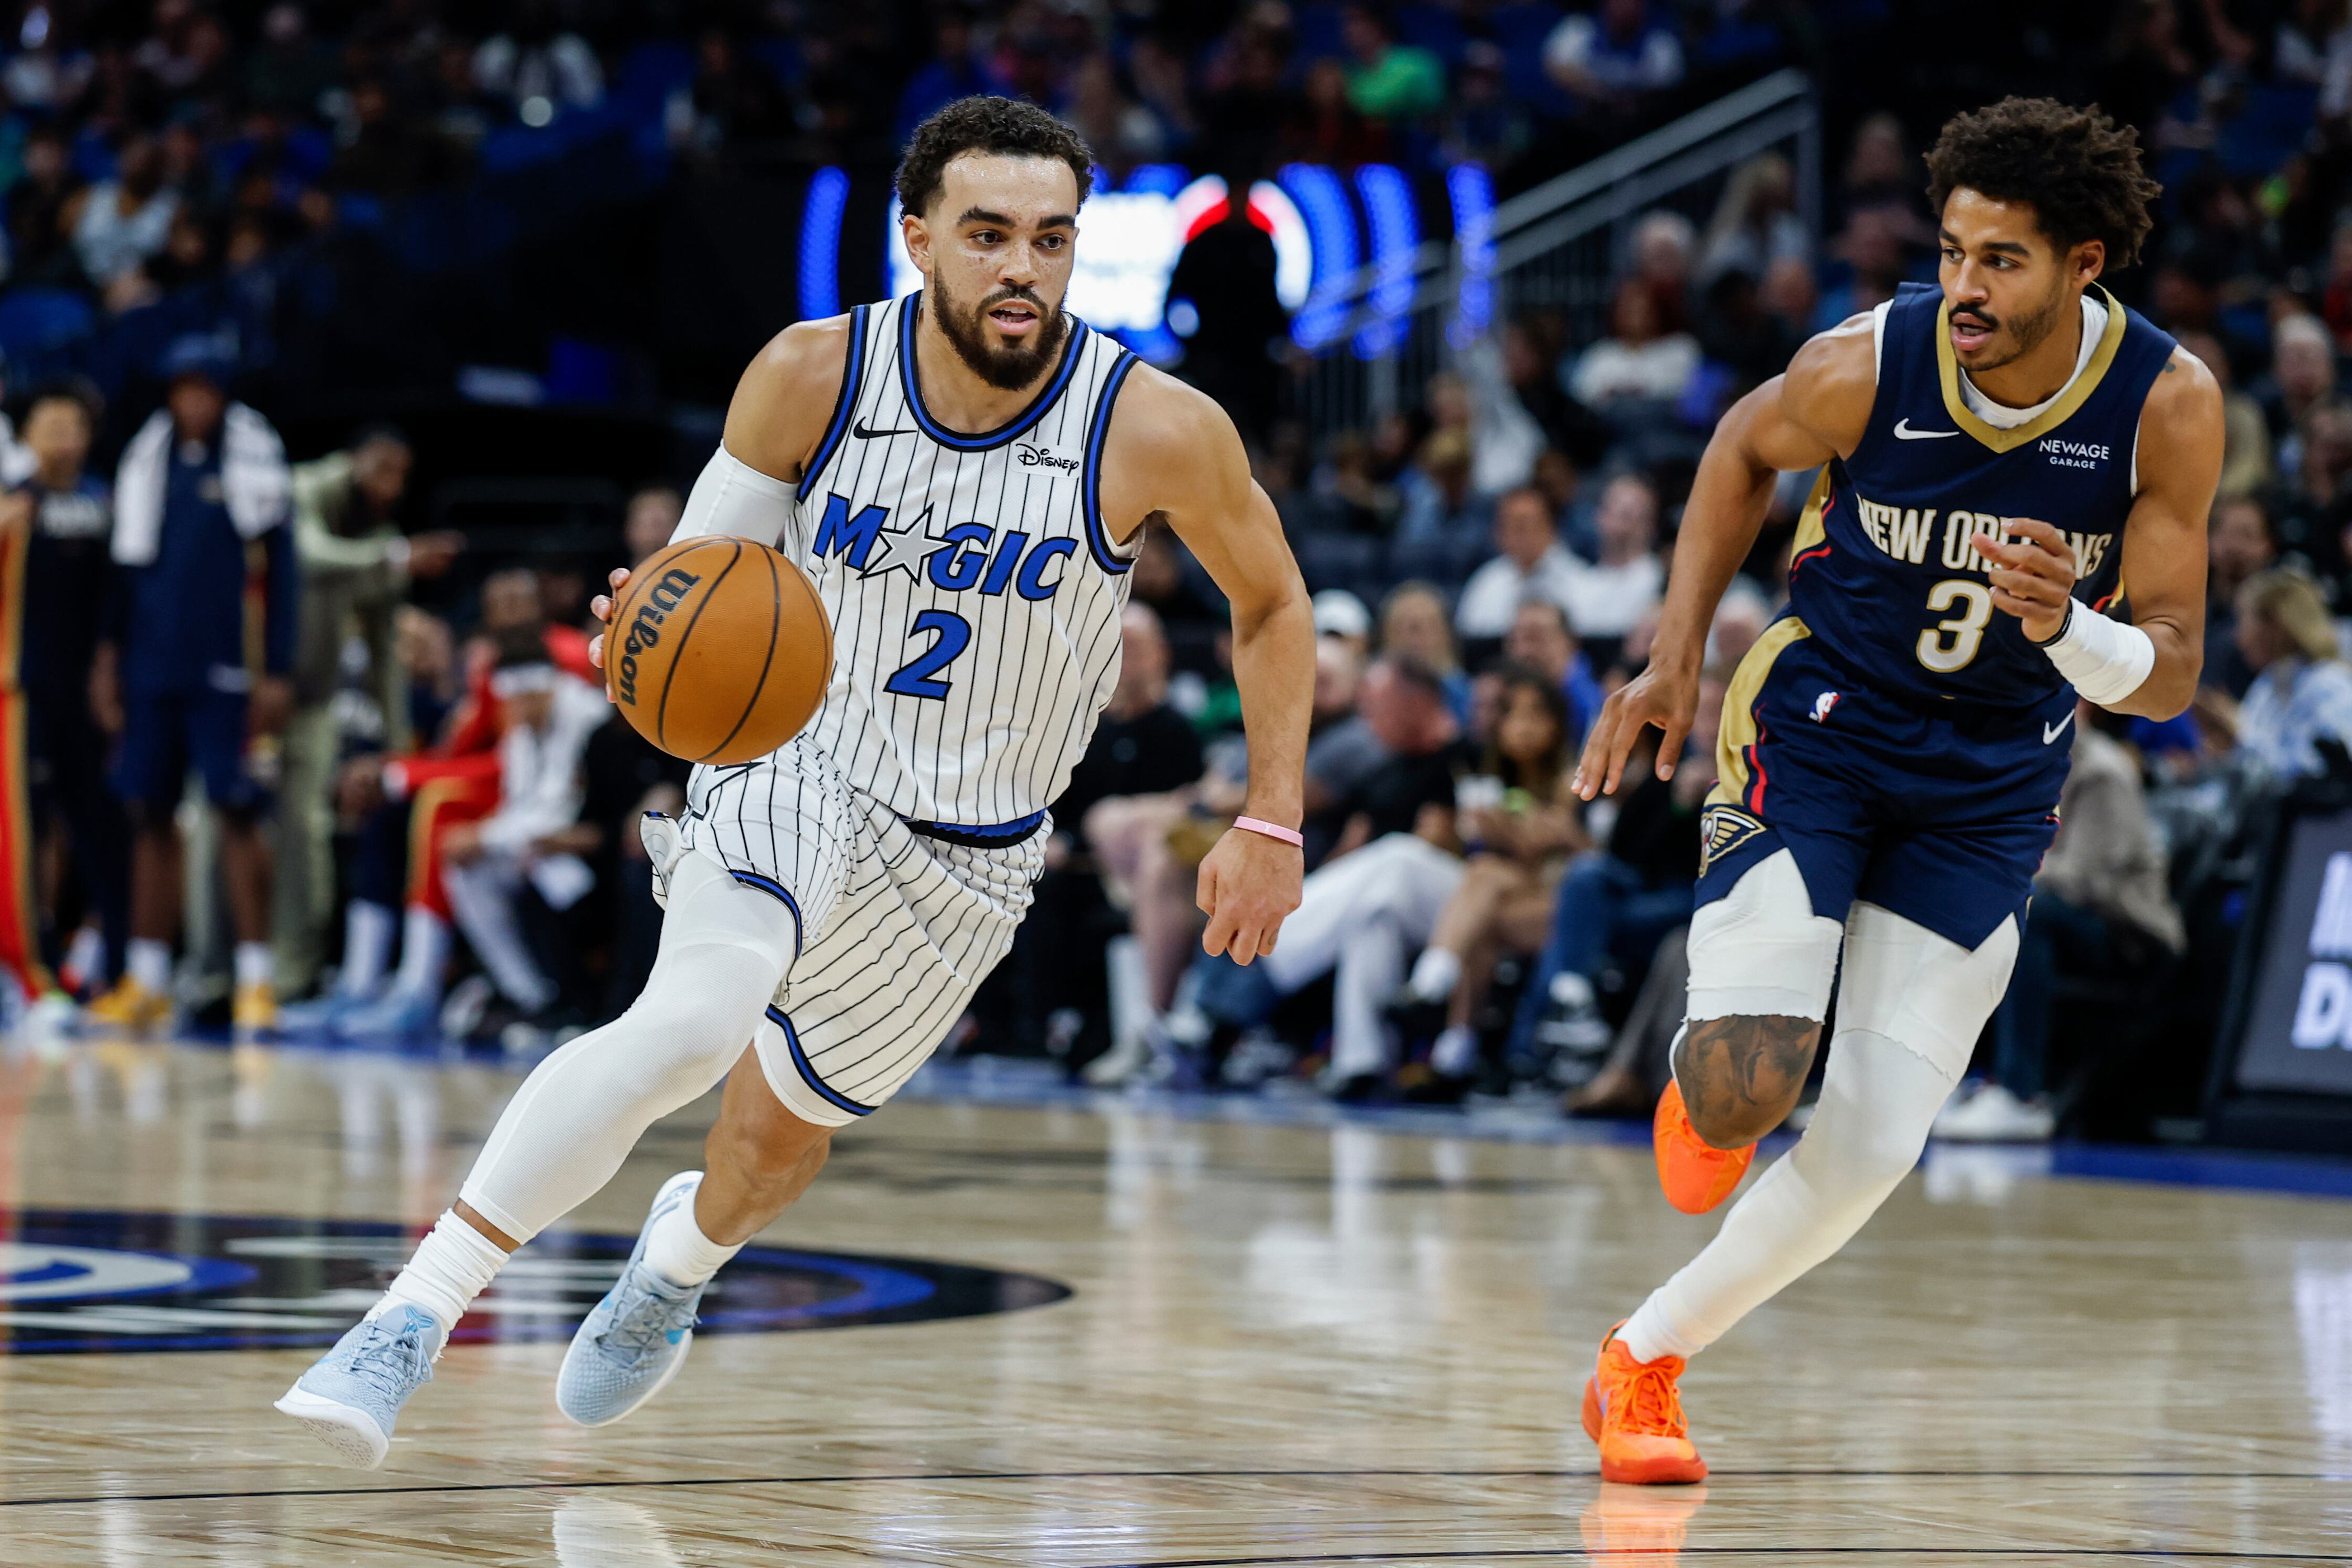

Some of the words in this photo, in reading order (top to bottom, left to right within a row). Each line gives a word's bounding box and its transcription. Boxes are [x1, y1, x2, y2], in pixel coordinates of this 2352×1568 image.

[1015, 443, 1080, 477] Disney
[2038, 439, 2110, 461] NEWAGE
[2048, 456, 2097, 470] GARAGE
[1856, 492, 1938, 565] NEW
[621, 569, 703, 705] Wilson
[883, 608, 972, 702] 2
[1915, 579, 1995, 674] 3
